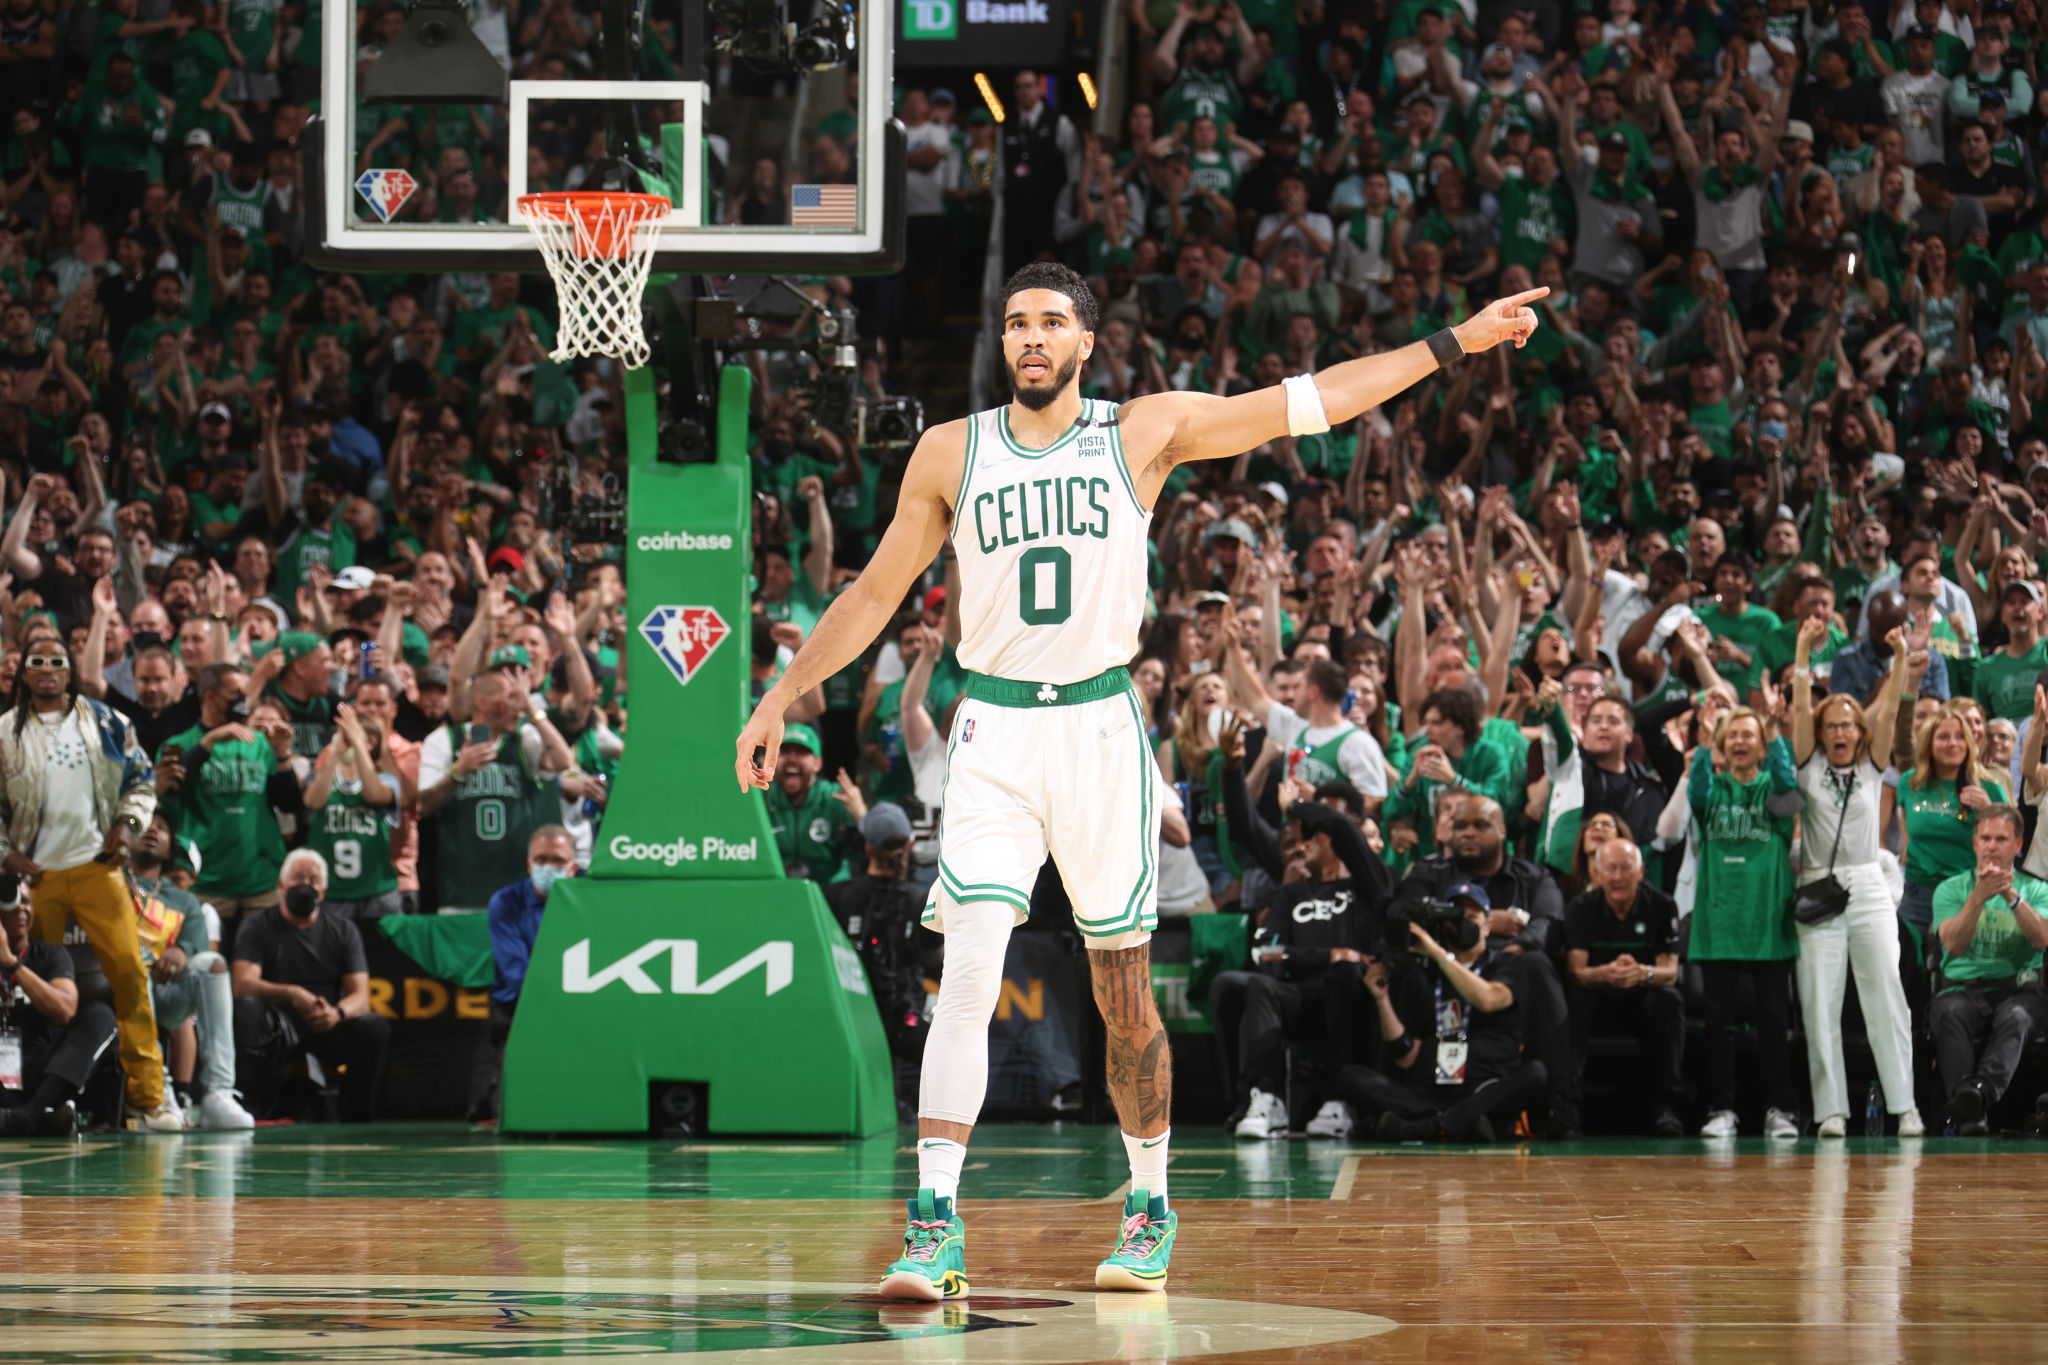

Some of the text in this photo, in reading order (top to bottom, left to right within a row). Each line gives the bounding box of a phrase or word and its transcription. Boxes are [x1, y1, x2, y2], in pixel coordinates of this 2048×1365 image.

[907, 0, 1048, 30] TD Bank
[1077, 436, 1106, 449] VISTA
[1078, 447, 1106, 459] PRINT
[974, 476, 1110, 555] CELTICS
[636, 530, 733, 551] coinbase
[1019, 545, 1072, 626] 0
[457, 762, 521, 800] ELTICS
[475, 798, 507, 841] 0
[333, 839, 362, 880] 9
[609, 834, 758, 868] Google Pixel
